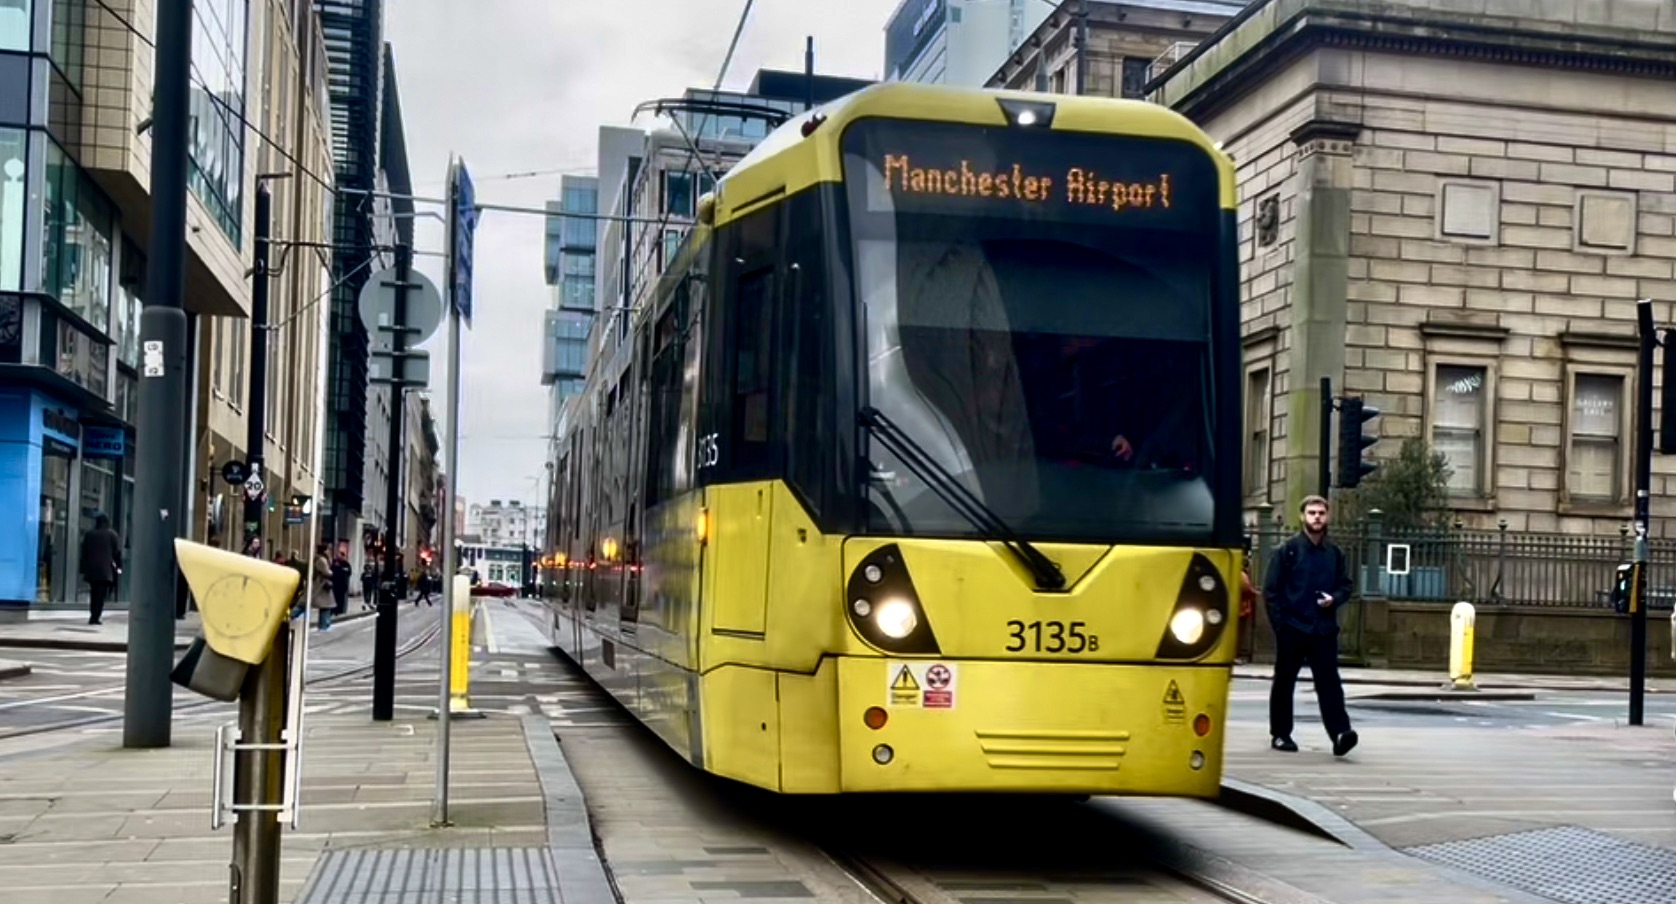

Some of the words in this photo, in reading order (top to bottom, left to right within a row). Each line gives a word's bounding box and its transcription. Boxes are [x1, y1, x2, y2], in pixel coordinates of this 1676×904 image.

[884, 154, 1051, 200] Manchester
[1066, 167, 1169, 210] Airport
[246, 481, 261, 491] 20
